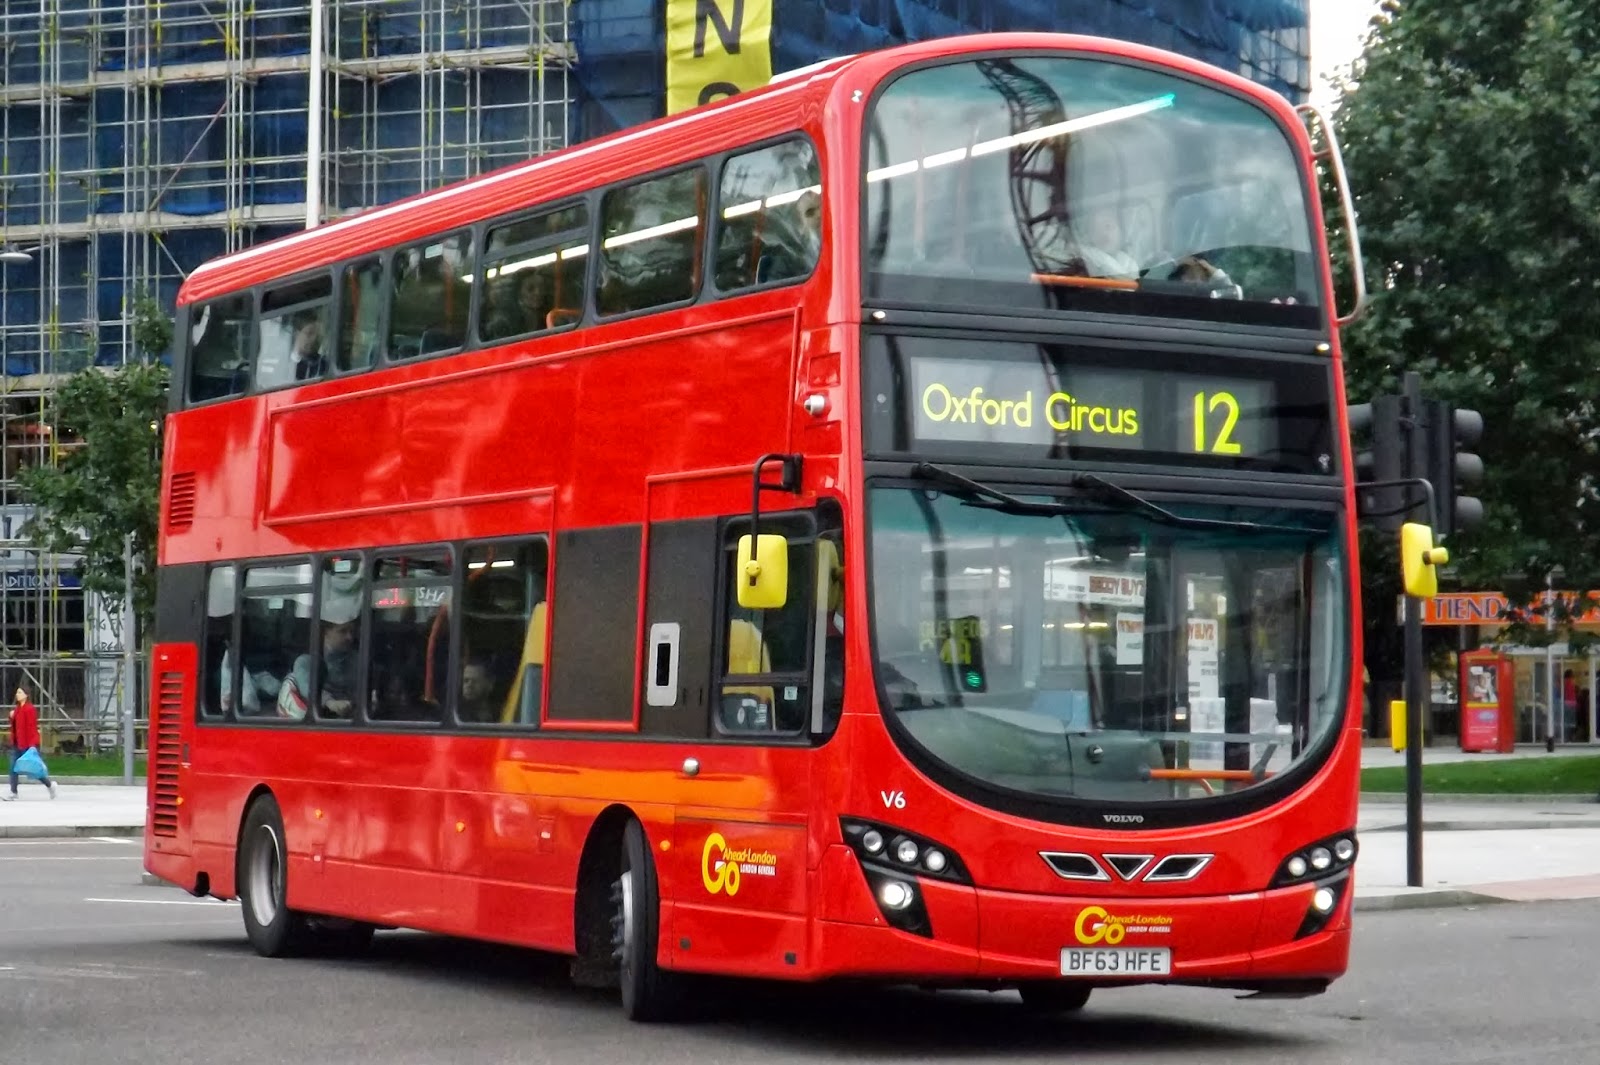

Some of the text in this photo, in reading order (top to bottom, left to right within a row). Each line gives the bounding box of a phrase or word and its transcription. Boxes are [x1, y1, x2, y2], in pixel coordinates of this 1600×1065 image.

[922, 382, 1139, 436] Oxford Circus
[1194, 391, 1241, 454] 12
[1434, 597, 1507, 620] TIEND
[880, 790, 906, 809] V6
[1103, 814, 1144, 823] VOLVO
[702, 832, 740, 896] Go
[740, 864, 776, 876] LONDON GENERAL
[1074, 906, 1126, 945] Go
[1069, 950, 1162, 972] BF63 HFE
